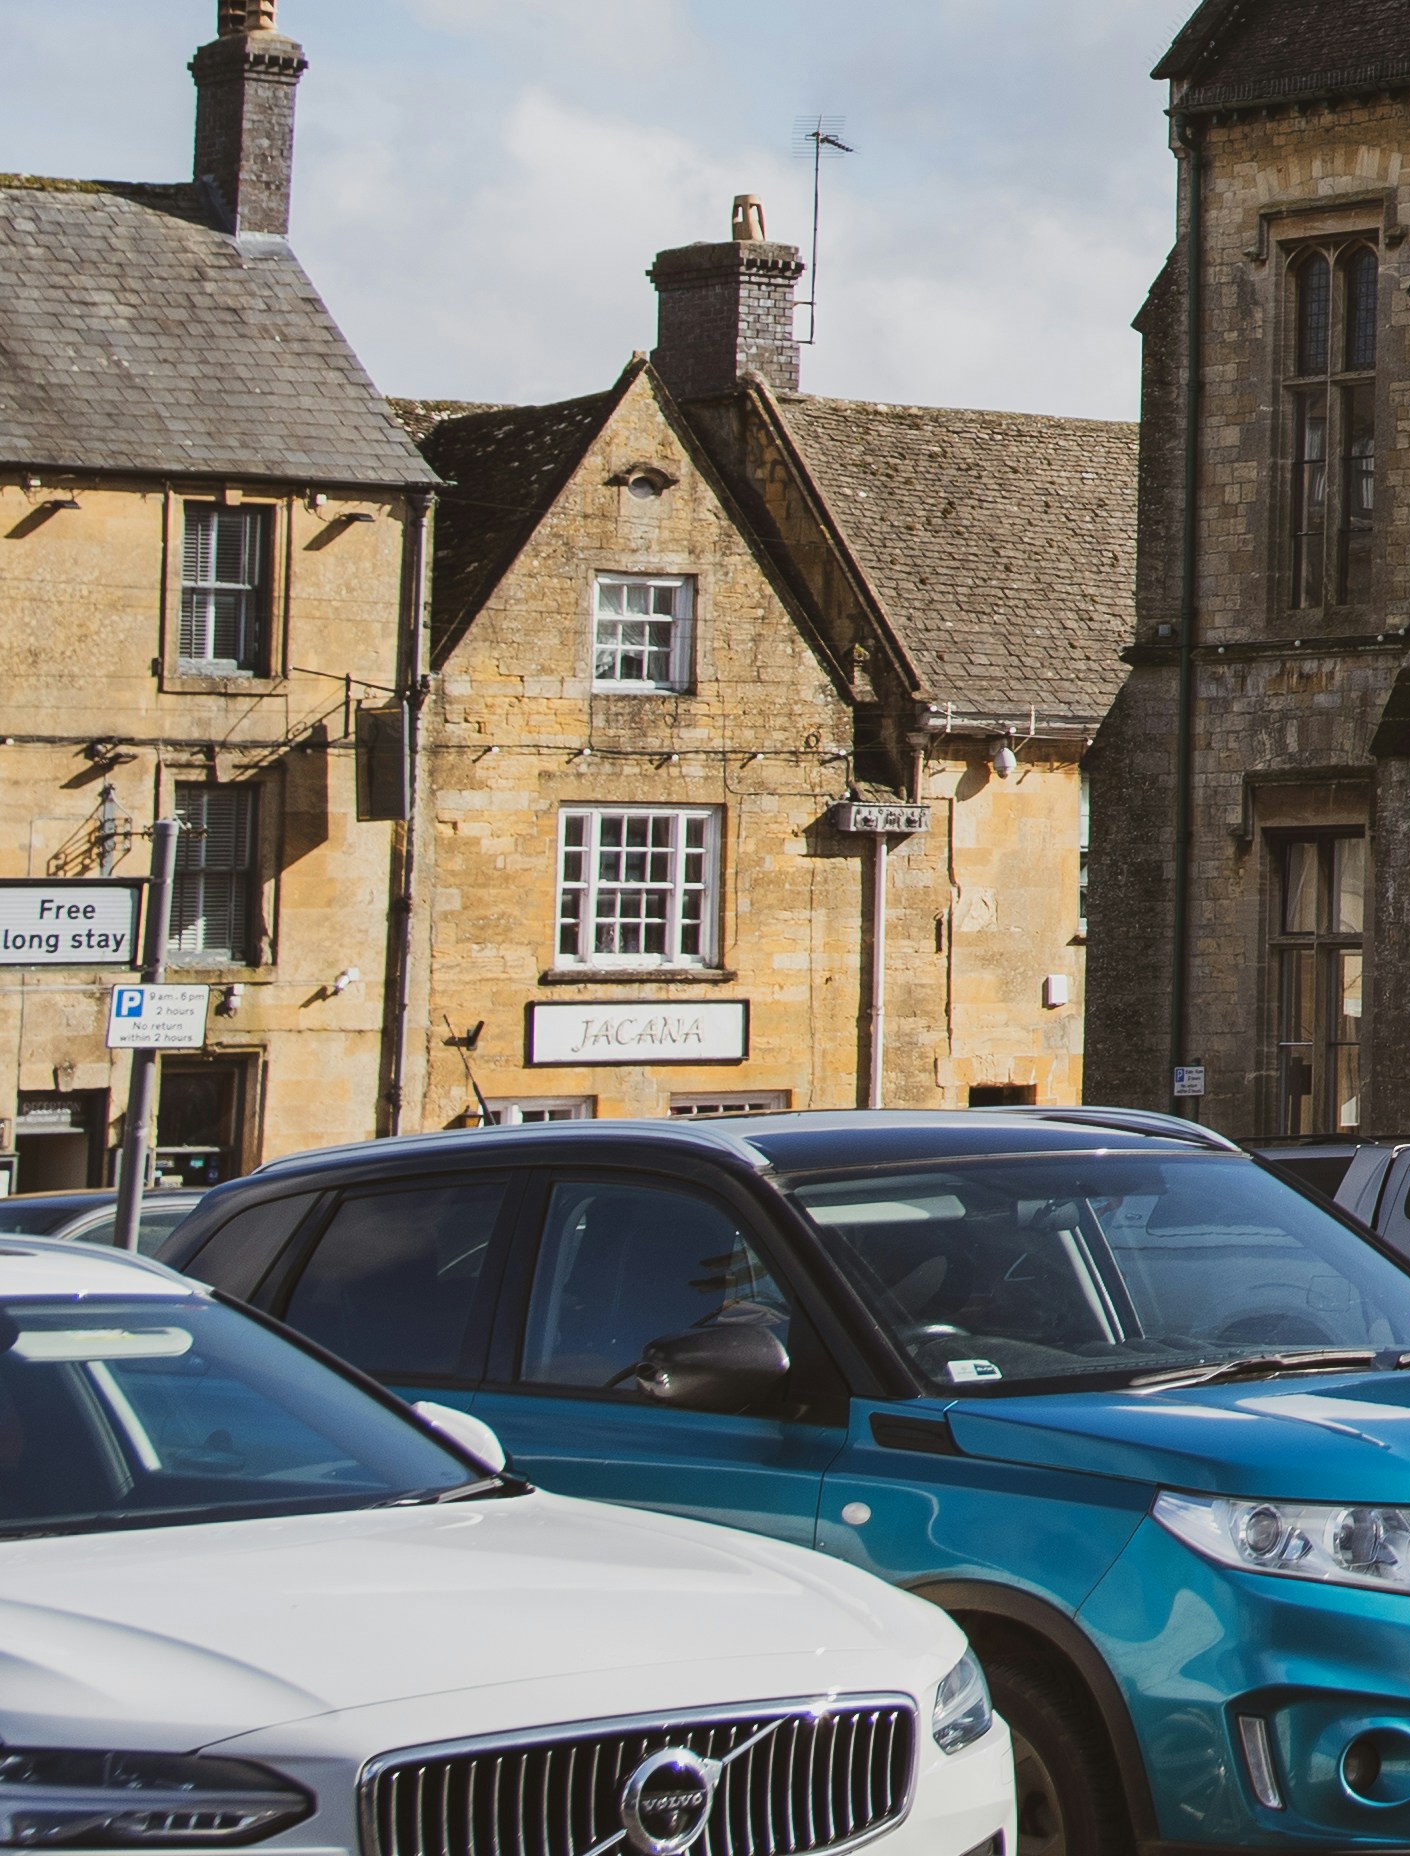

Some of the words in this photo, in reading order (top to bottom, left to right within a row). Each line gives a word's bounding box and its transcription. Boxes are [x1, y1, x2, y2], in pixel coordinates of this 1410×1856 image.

[40, 899, 96, 920] Free
[3, 928, 60, 954] long
[70, 928, 126, 953] stay
[121, 990, 142, 1016] P
[149, 992, 156, 1001] 9
[181, 992, 187, 1001] 6
[188, 994, 205, 1002] pm
[156, 1007, 163, 1015] 2
[166, 1007, 195, 1015] hours
[132, 1022, 147, 1030] No
[151, 1022, 183, 1030] return
[571, 1016, 703, 1053] JACANA
[120, 1034, 151, 1042] within
[154, 1033, 161, 1042] 2
[164, 1033, 193, 1042] hours
[641, 1792, 703, 1812] VOLVO
